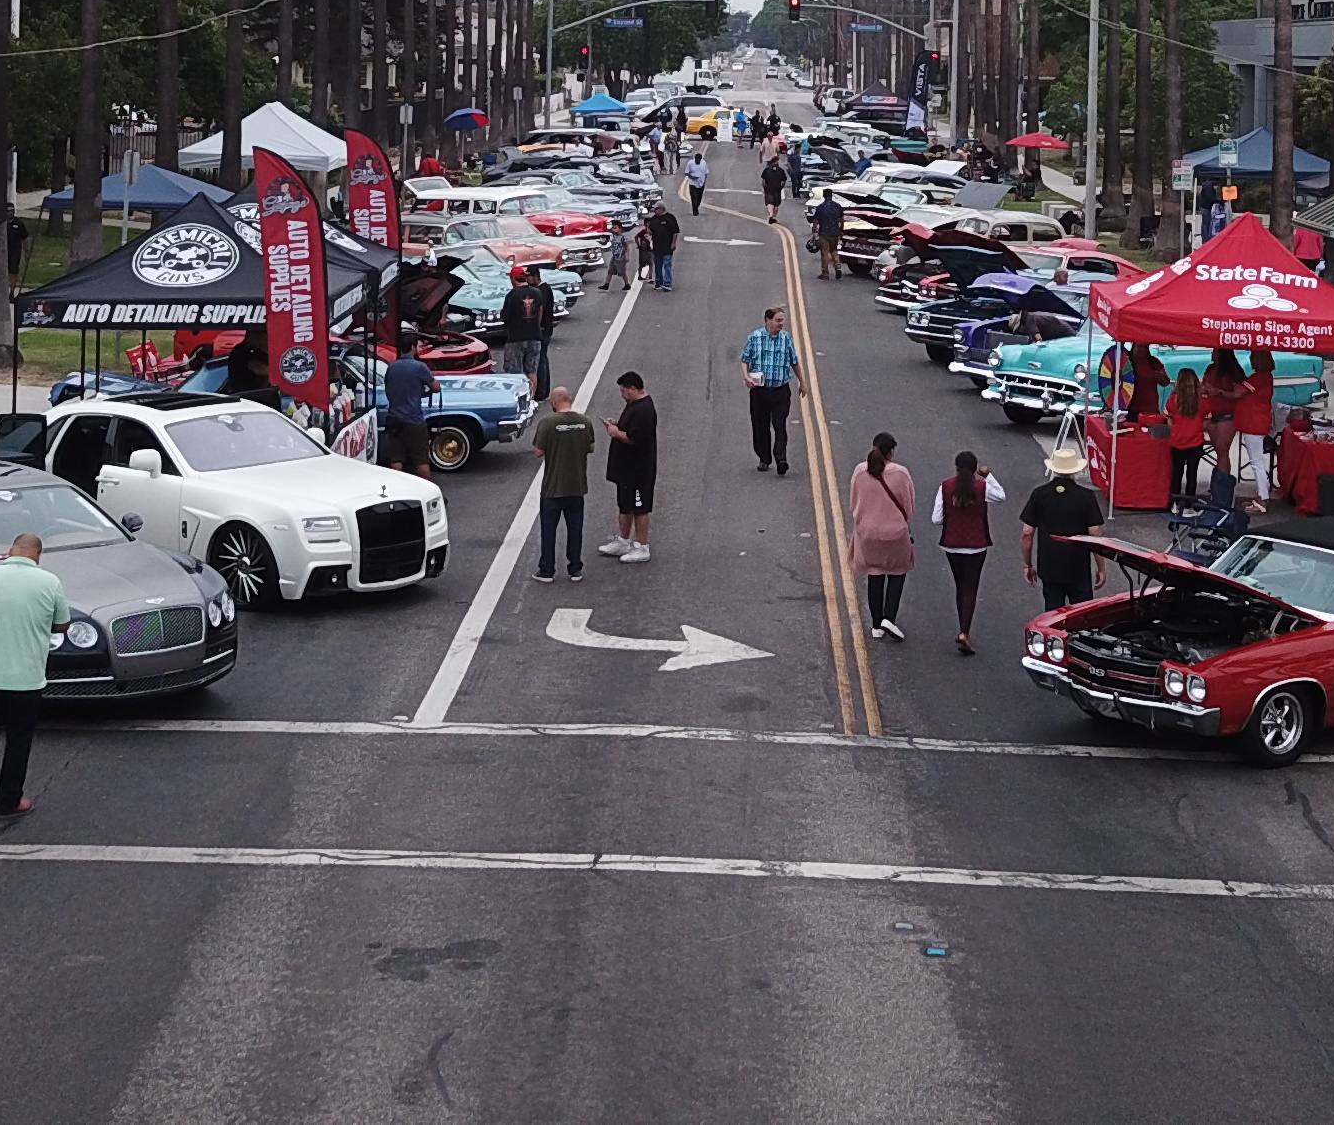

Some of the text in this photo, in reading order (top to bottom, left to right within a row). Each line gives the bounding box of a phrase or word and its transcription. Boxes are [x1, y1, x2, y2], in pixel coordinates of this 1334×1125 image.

[369, 189, 387, 225] AUTO
[143, 228, 232, 262] CHEMICAL
[286, 220, 310, 260] AUTO
[155, 271, 205, 284] GUYS
[268, 244, 292, 313] SUPPLIES
[62, 303, 111, 324] AUTO
[111, 303, 198, 324] DETAILING
[199, 304, 267, 324] SUPPLIE
[290, 264, 314, 343] DETAILING
[1201, 317, 1262, 332] Stephanie
[1297, 323, 1333, 337] Agent
[1219, 333, 1316, 350] (805) 941-3300
